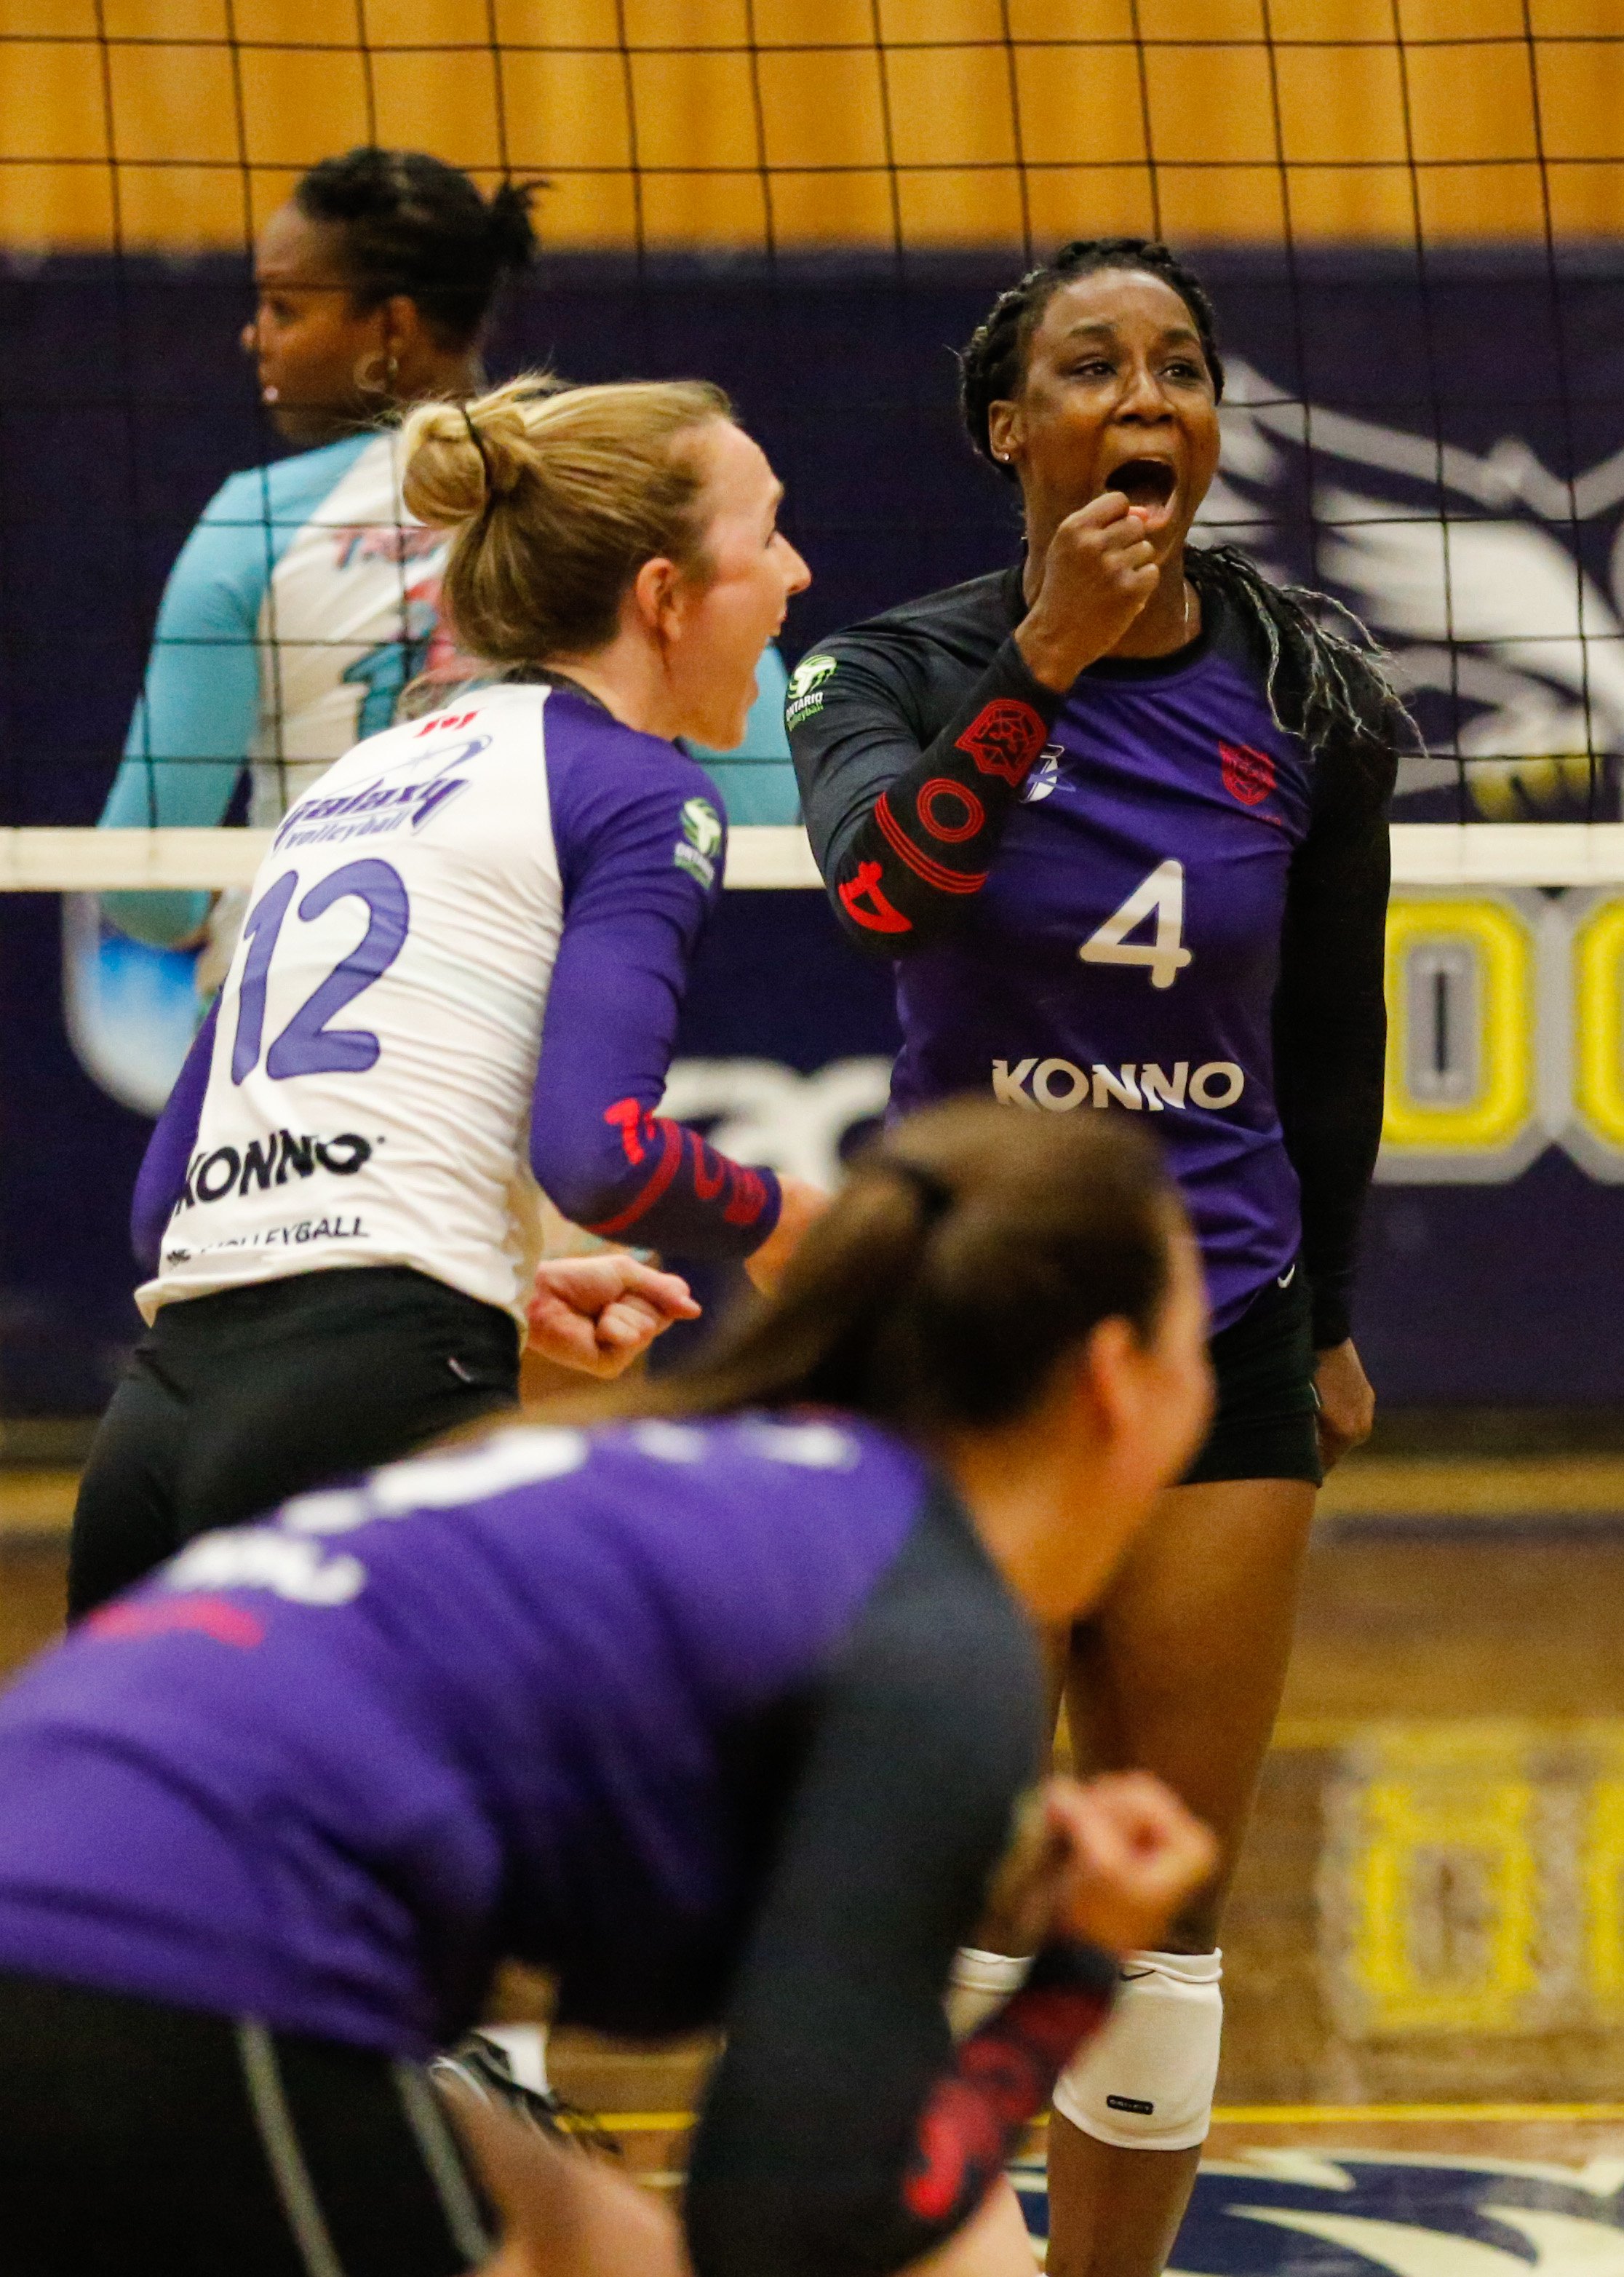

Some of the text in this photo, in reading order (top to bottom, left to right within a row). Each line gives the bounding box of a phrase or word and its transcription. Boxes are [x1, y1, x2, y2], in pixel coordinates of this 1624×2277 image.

[231, 858, 410, 1086] 12
[1080, 859, 1193, 988] 4
[992, 1058, 1245, 1113] KONNO
[175, 1129, 372, 1217] KONNO
